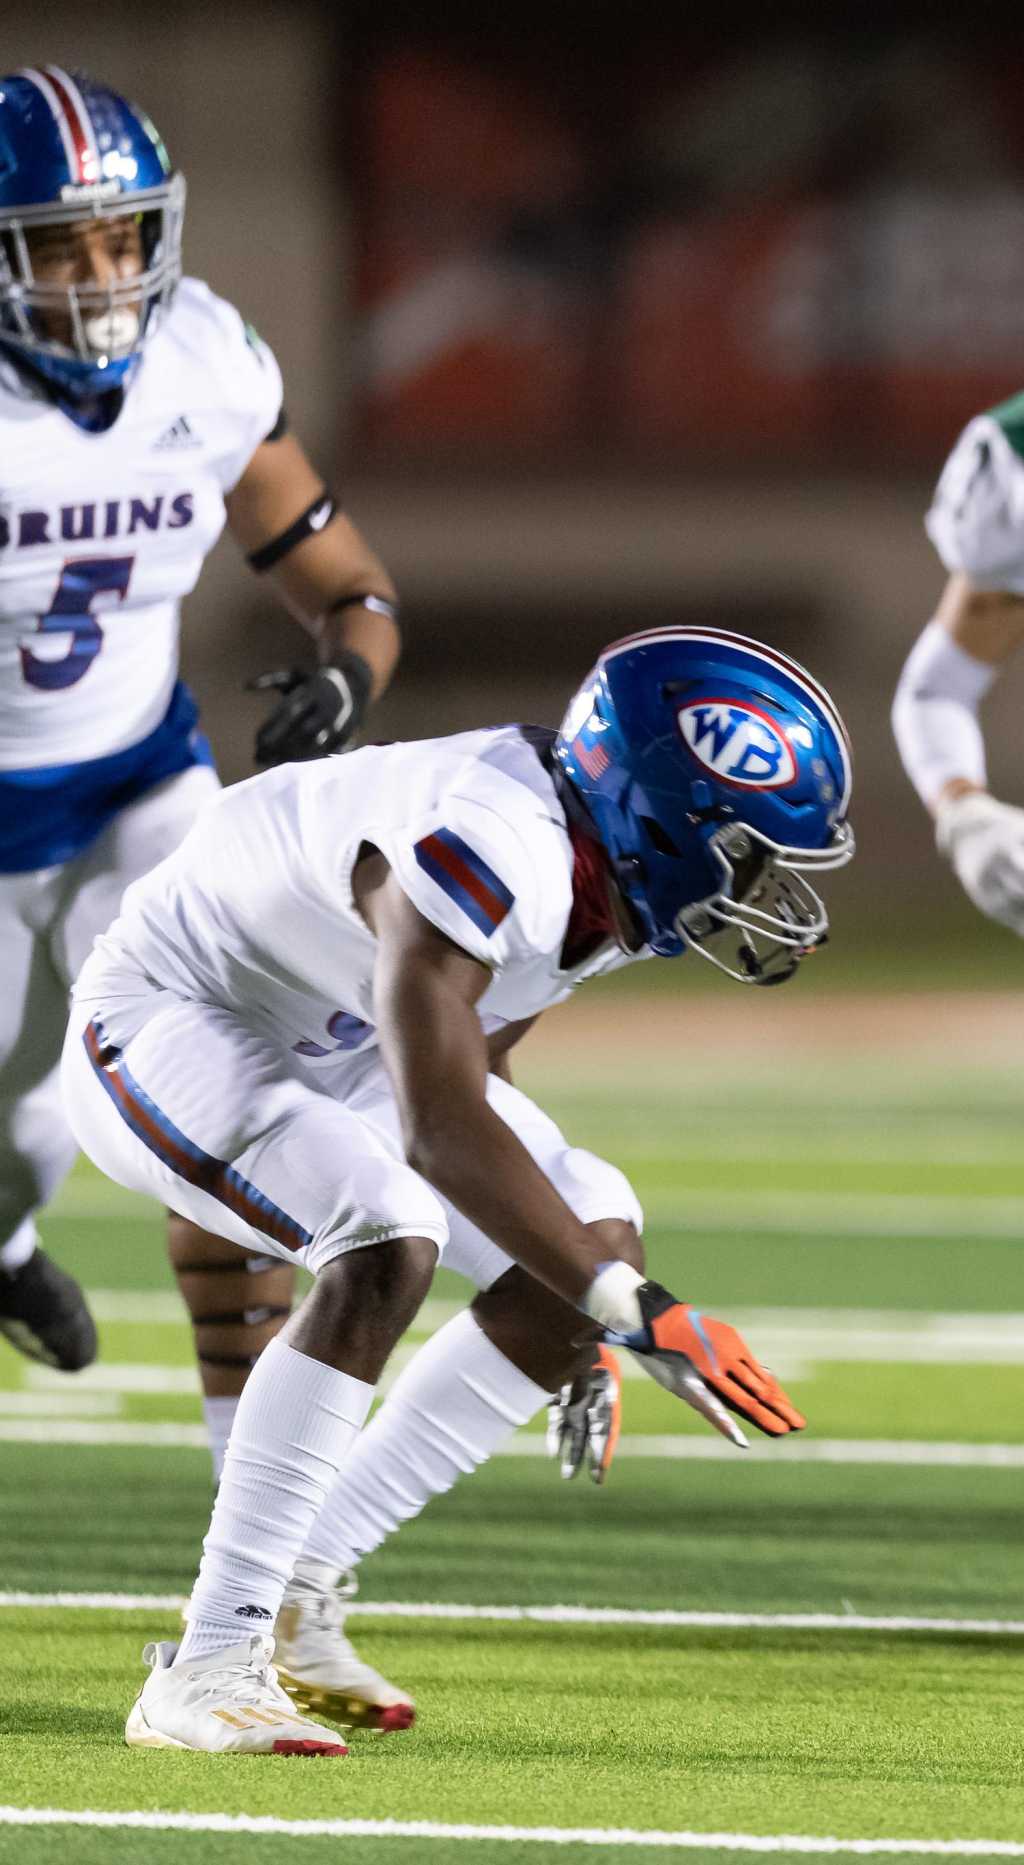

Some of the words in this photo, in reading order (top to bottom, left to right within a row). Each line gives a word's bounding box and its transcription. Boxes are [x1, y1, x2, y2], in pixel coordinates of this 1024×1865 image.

[0, 494, 193, 548] RUINS
[18, 555, 135, 690] 5
[691, 708, 782, 781] WB
